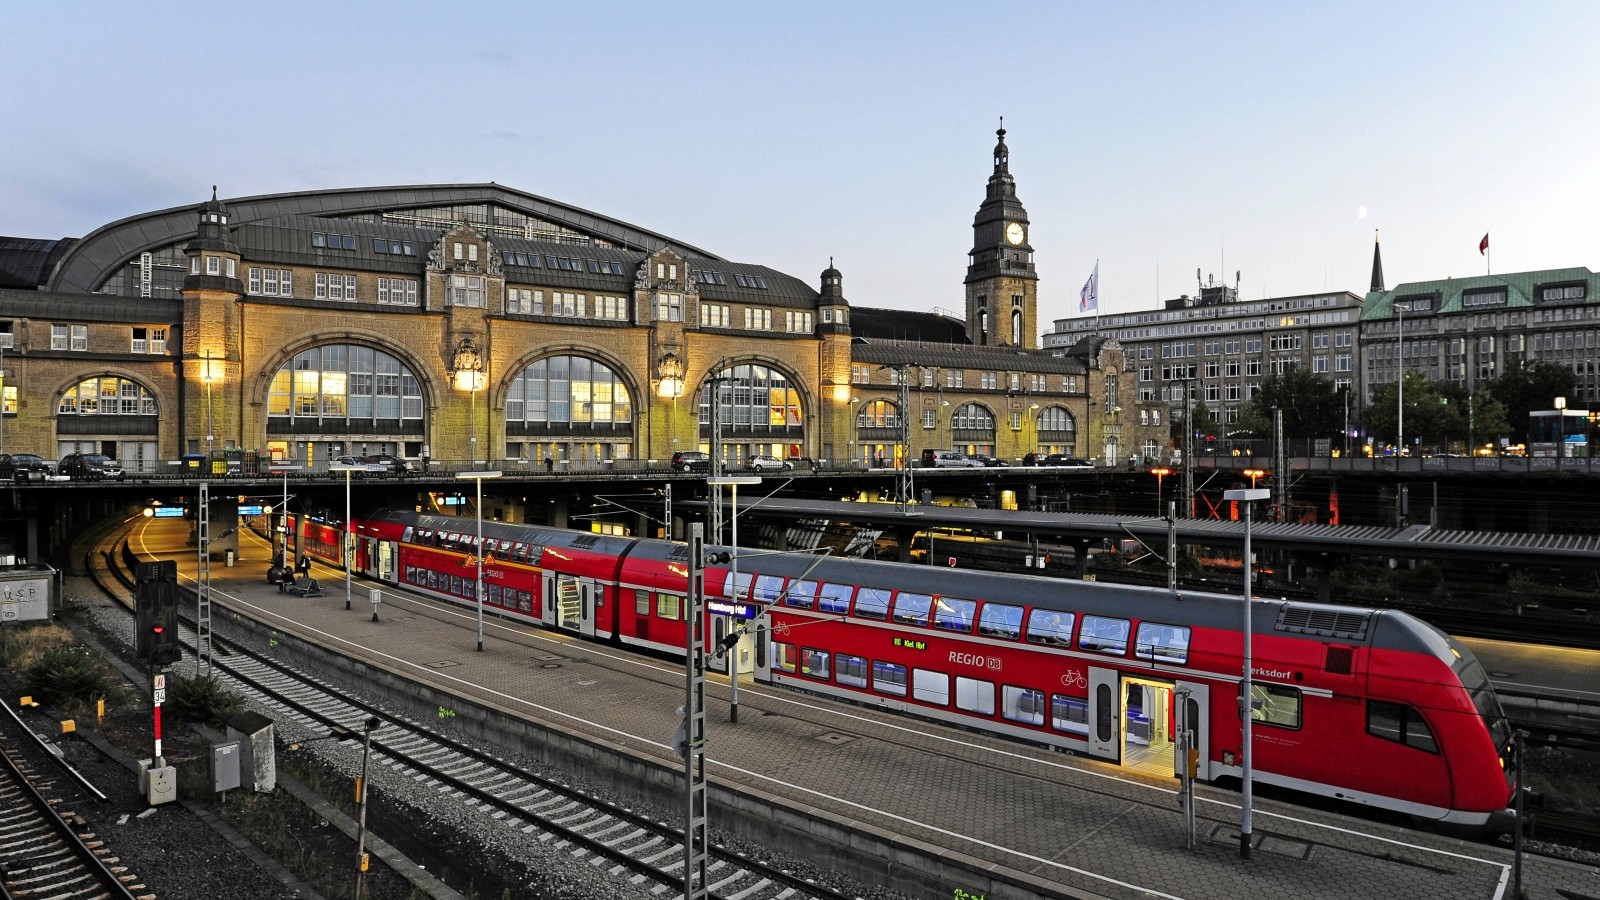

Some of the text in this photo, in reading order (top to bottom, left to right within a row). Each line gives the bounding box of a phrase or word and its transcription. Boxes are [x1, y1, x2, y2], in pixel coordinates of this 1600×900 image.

[708, 601, 734, 615] Hamburg
[915, 641, 925, 650] Hbf
[948, 651, 1001, 670] REGIO DB
[1242, 665, 1291, 679] erksdorf
[155, 691, 164, 702] 34
